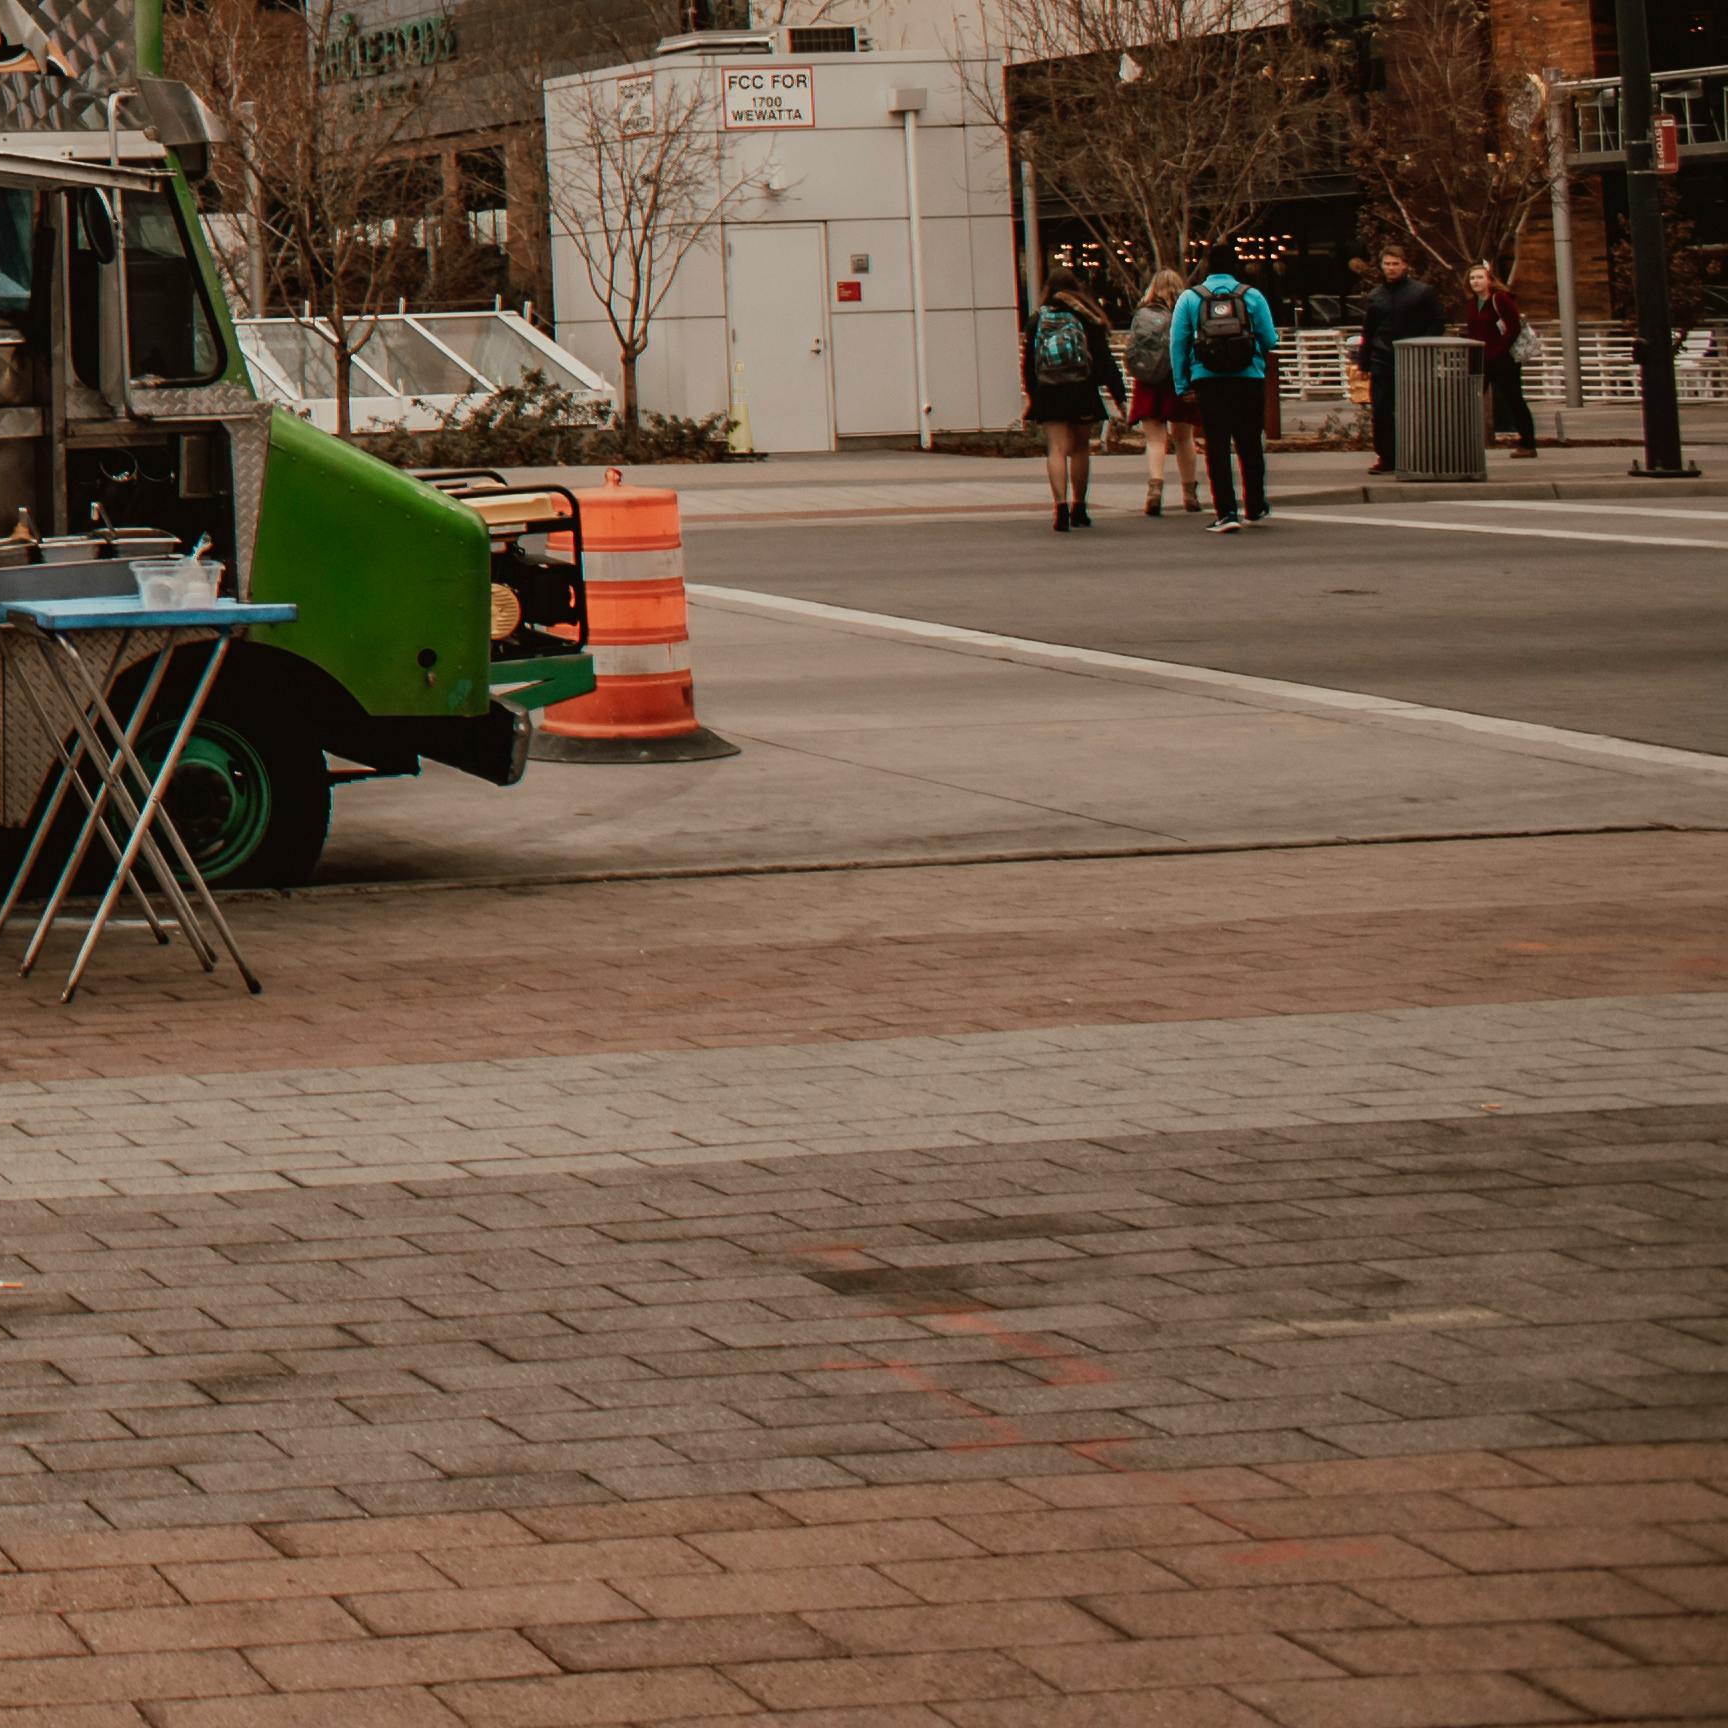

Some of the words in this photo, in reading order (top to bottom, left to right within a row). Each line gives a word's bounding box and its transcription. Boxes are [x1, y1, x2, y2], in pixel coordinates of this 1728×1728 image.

[728, 75, 763, 90] FCC
[771, 74, 808, 88] FOR
[752, 96, 782, 108] 1700
[731, 109, 803, 121] WEWATTA
[1654, 128, 1665, 160] STOP
